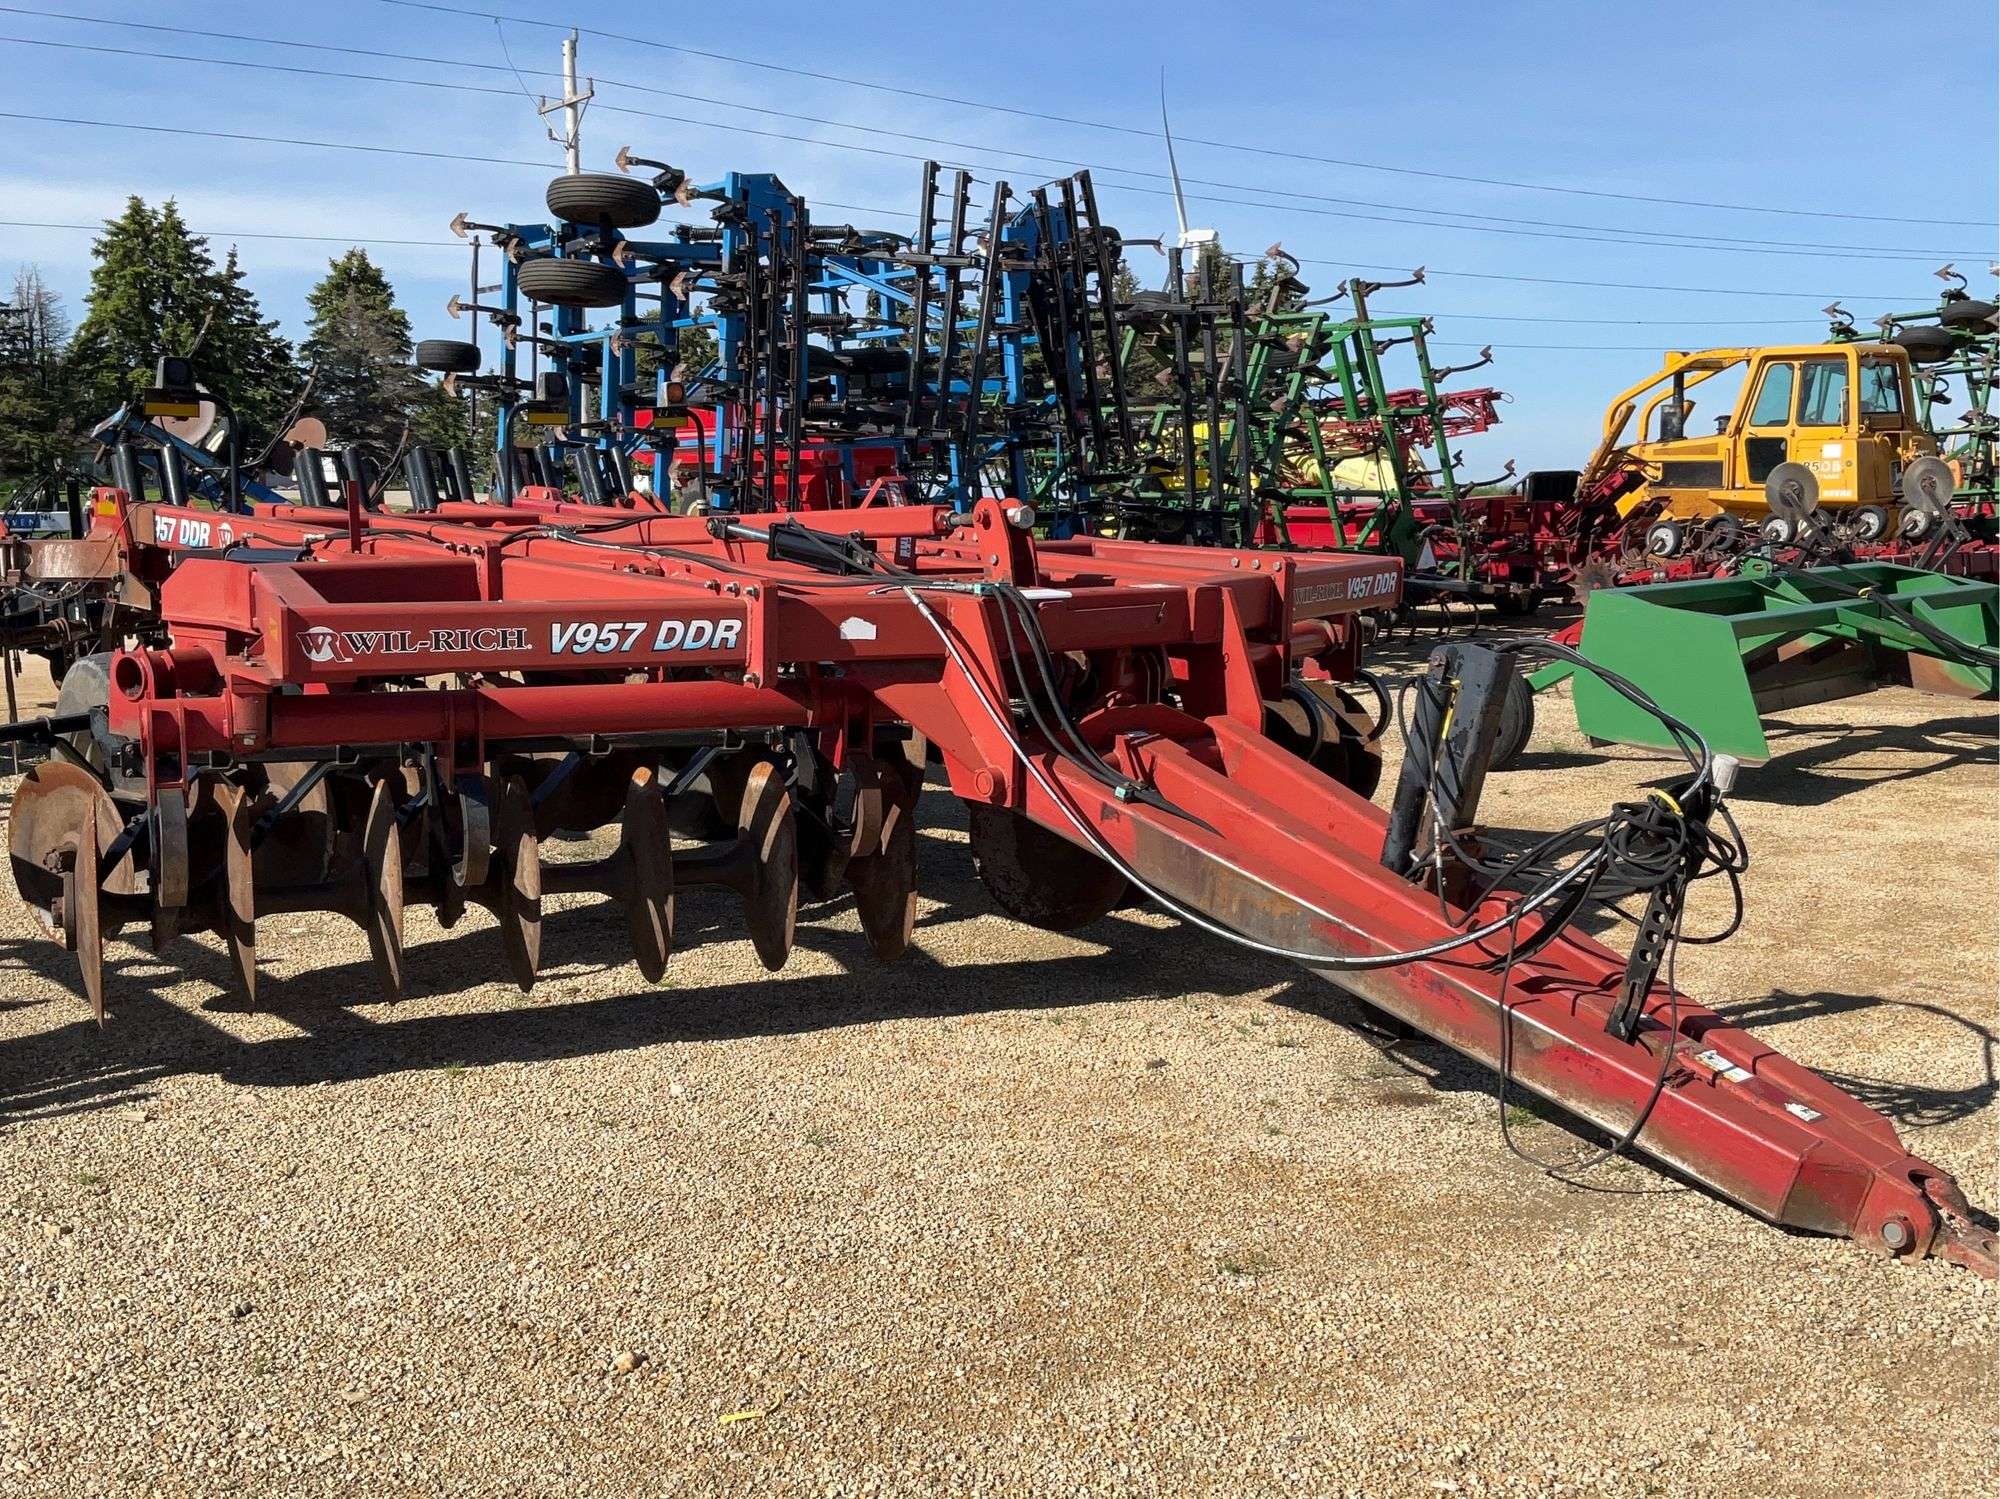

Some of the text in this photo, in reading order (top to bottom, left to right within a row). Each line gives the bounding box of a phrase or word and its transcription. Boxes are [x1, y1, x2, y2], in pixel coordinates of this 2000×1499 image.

[179, 518, 211, 547] DDR
[1347, 577, 1374, 600] V957
[1373, 572, 1398, 595] DDR
[550, 621, 648, 654] V957
[653, 618, 743, 651] DDR
